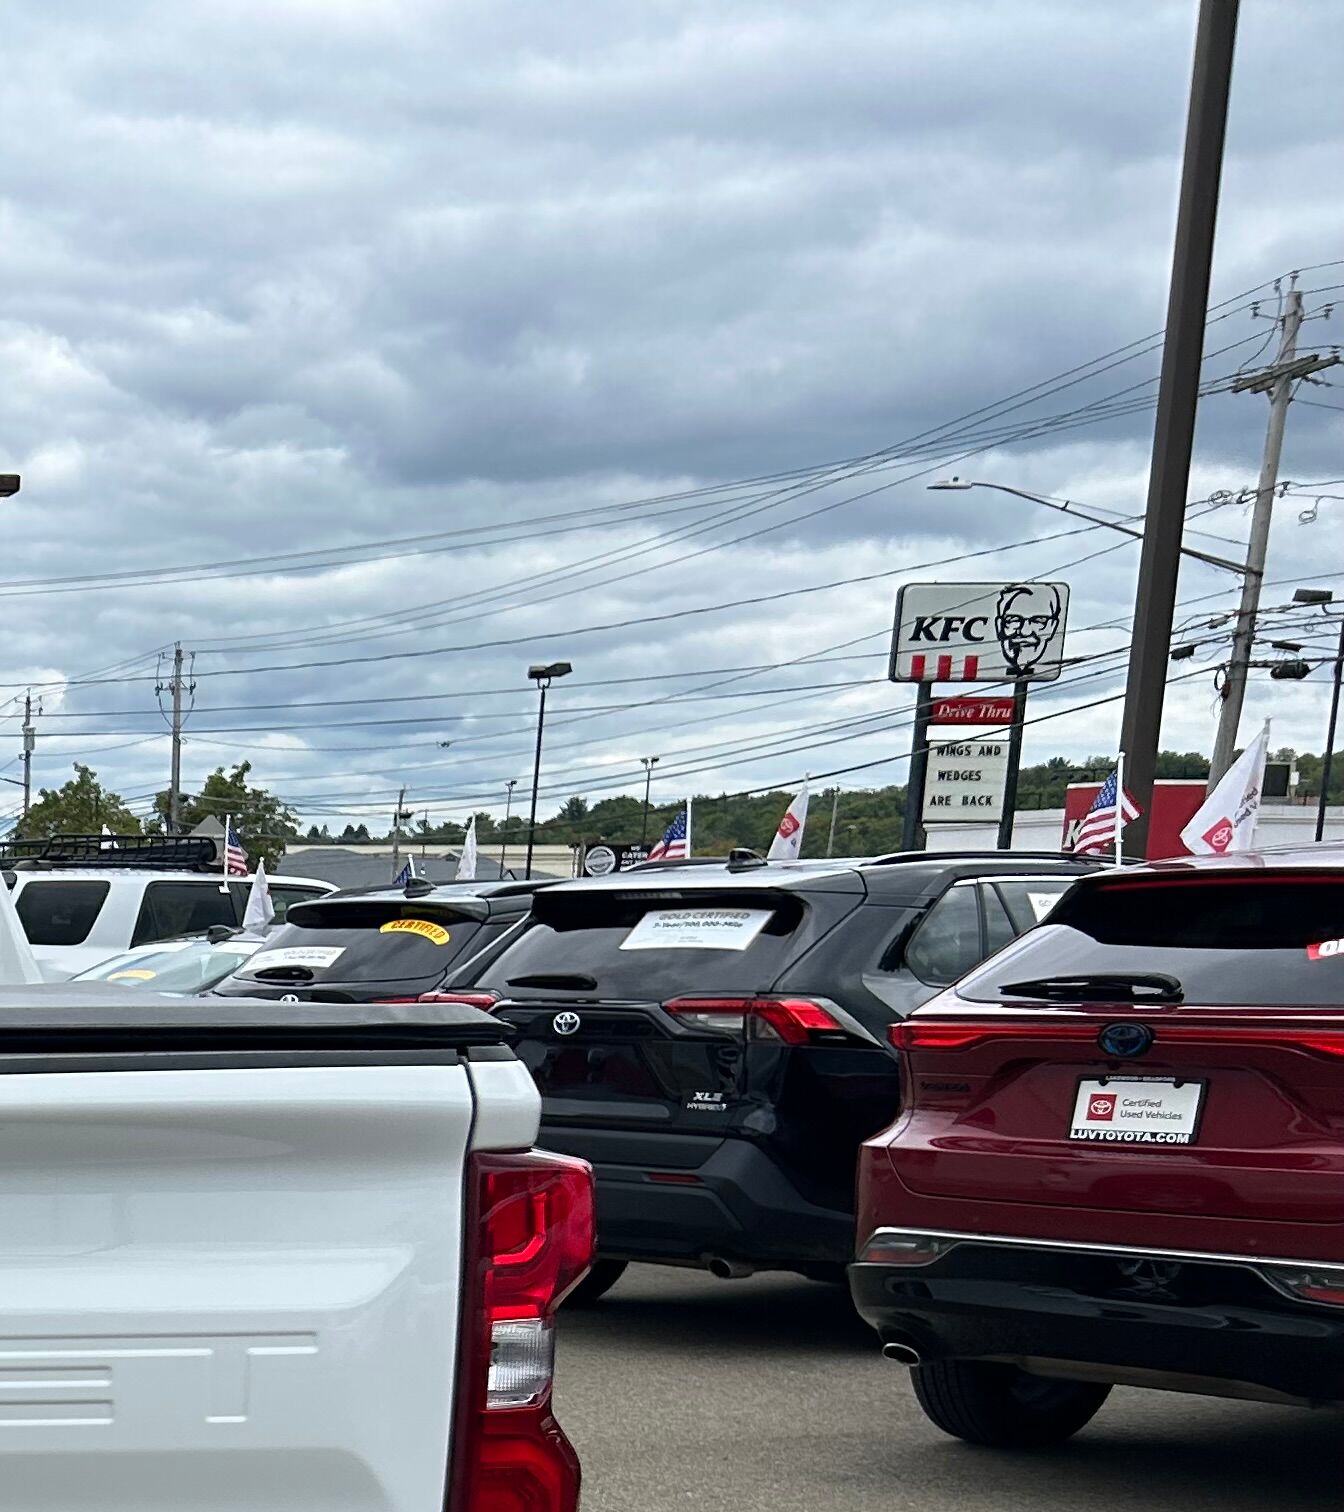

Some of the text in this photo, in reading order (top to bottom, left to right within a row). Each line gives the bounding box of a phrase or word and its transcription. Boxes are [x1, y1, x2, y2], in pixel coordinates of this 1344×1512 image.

[909, 616, 989, 642] KFC
[938, 703, 1012, 719] Drive Thru
[936, 745, 1002, 756] WINGS AND
[938, 770, 982, 781] WEDGES
[929, 795, 993, 806] ARE BACK
[693, 911, 751, 920] CERTIFIED
[391, 920, 446, 939] CERTIFIED
[1122, 1098, 1162, 1108] Certified
[1120, 1109, 1183, 1120] Used Vehicles
[1069, 1129, 1190, 1144] LUVTOYOTA.COM
